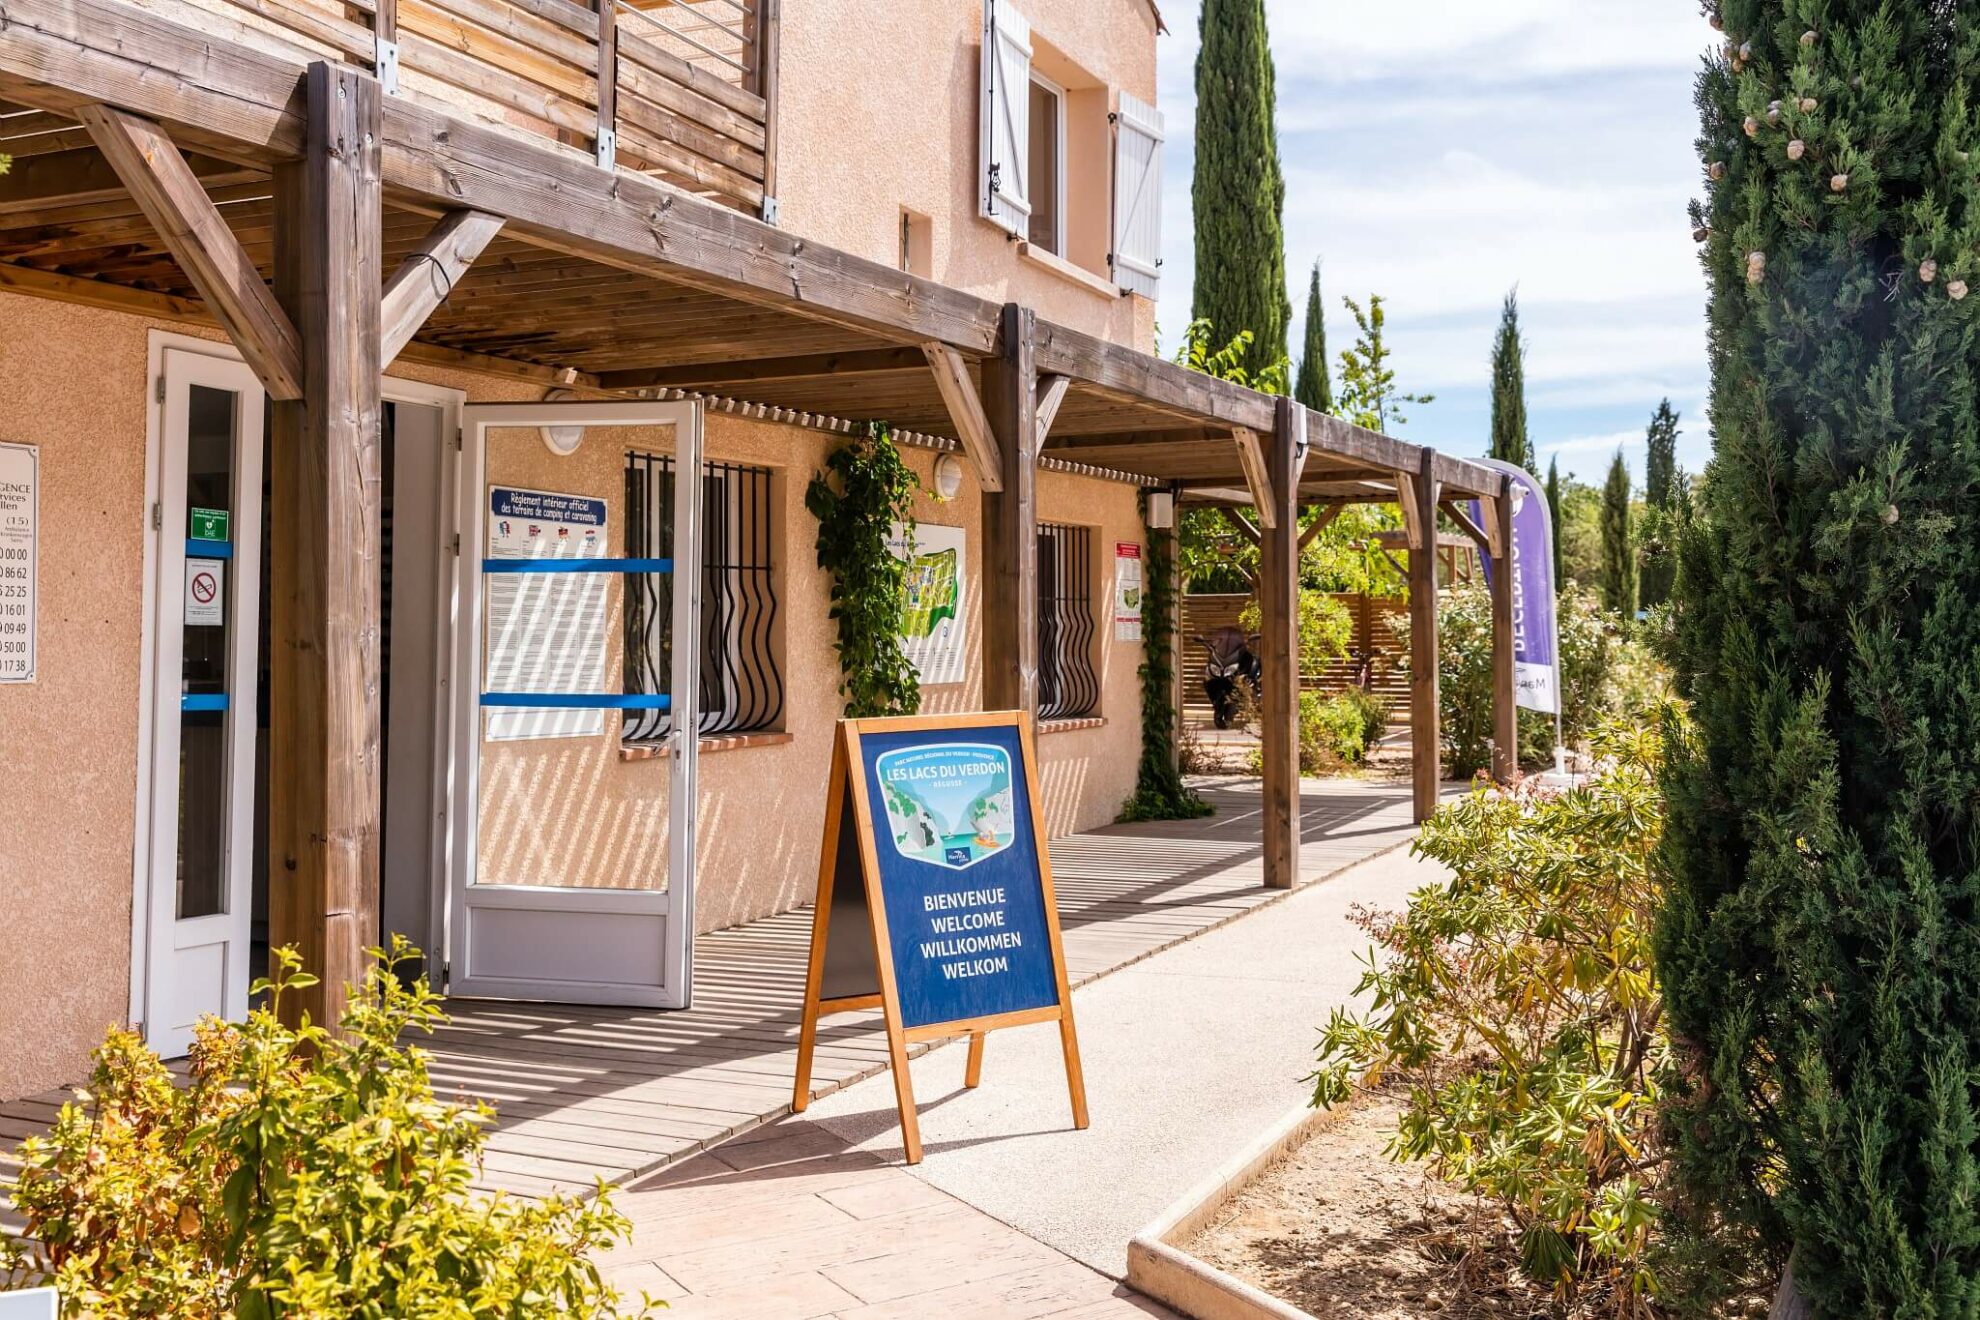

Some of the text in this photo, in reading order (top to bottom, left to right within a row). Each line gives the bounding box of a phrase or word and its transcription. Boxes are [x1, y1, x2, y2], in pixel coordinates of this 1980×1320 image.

[510, 493, 541, 507] Règlement
[568, 499, 589, 511] officiel
[501, 502, 511, 514] des
[512, 504, 534, 516] terrains
[535, 506, 542, 517] de
[543, 508, 563, 521] camping
[564, 510, 571, 519] et
[5, 549, 27, 561] 00 00
[5, 567, 27, 579] 86 62
[5, 586, 26, 598] 25 25
[5, 604, 25, 616] 16 01
[5, 623, 26, 635] 09 49
[4, 641, 25, 653] 50 00
[4, 660, 25, 672] 17 38
[887, 762, 1005, 781] LES LACS DU VERDON
[923, 887, 1006, 912] BIENVENUE
[931, 911, 1005, 934] WELCOME
[920, 931, 1022, 959] WILLKOMMEN
[942, 956, 1008, 980] WELKOM
